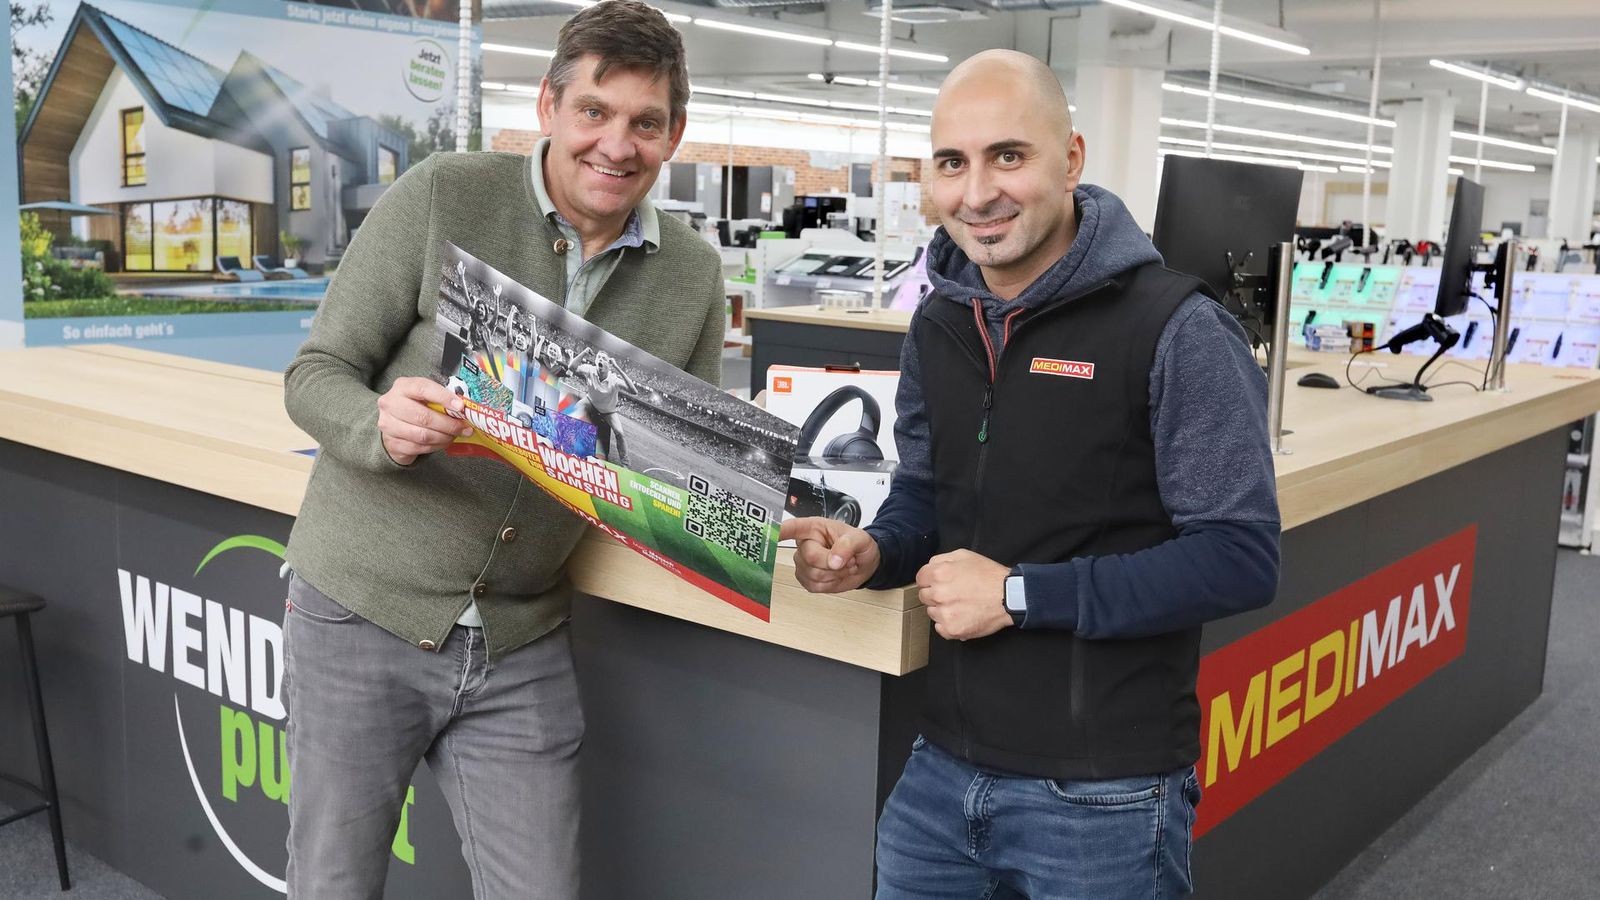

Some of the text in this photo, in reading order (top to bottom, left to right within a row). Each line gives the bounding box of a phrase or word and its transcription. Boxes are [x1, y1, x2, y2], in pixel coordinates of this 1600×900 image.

[418, 49, 441, 65] Jetzt
[63, 325, 80, 339] So
[84, 323, 132, 338] einfach
[1033, 361, 1090, 375] MEDIMAX
[463, 399, 501, 419] EDIMAX
[538, 445, 618, 493] WOCHEN
[545, 467, 630, 509] SAMSUNG
[118, 568, 287, 720] WEND
[1205, 563, 1461, 788] MEDIMAX
